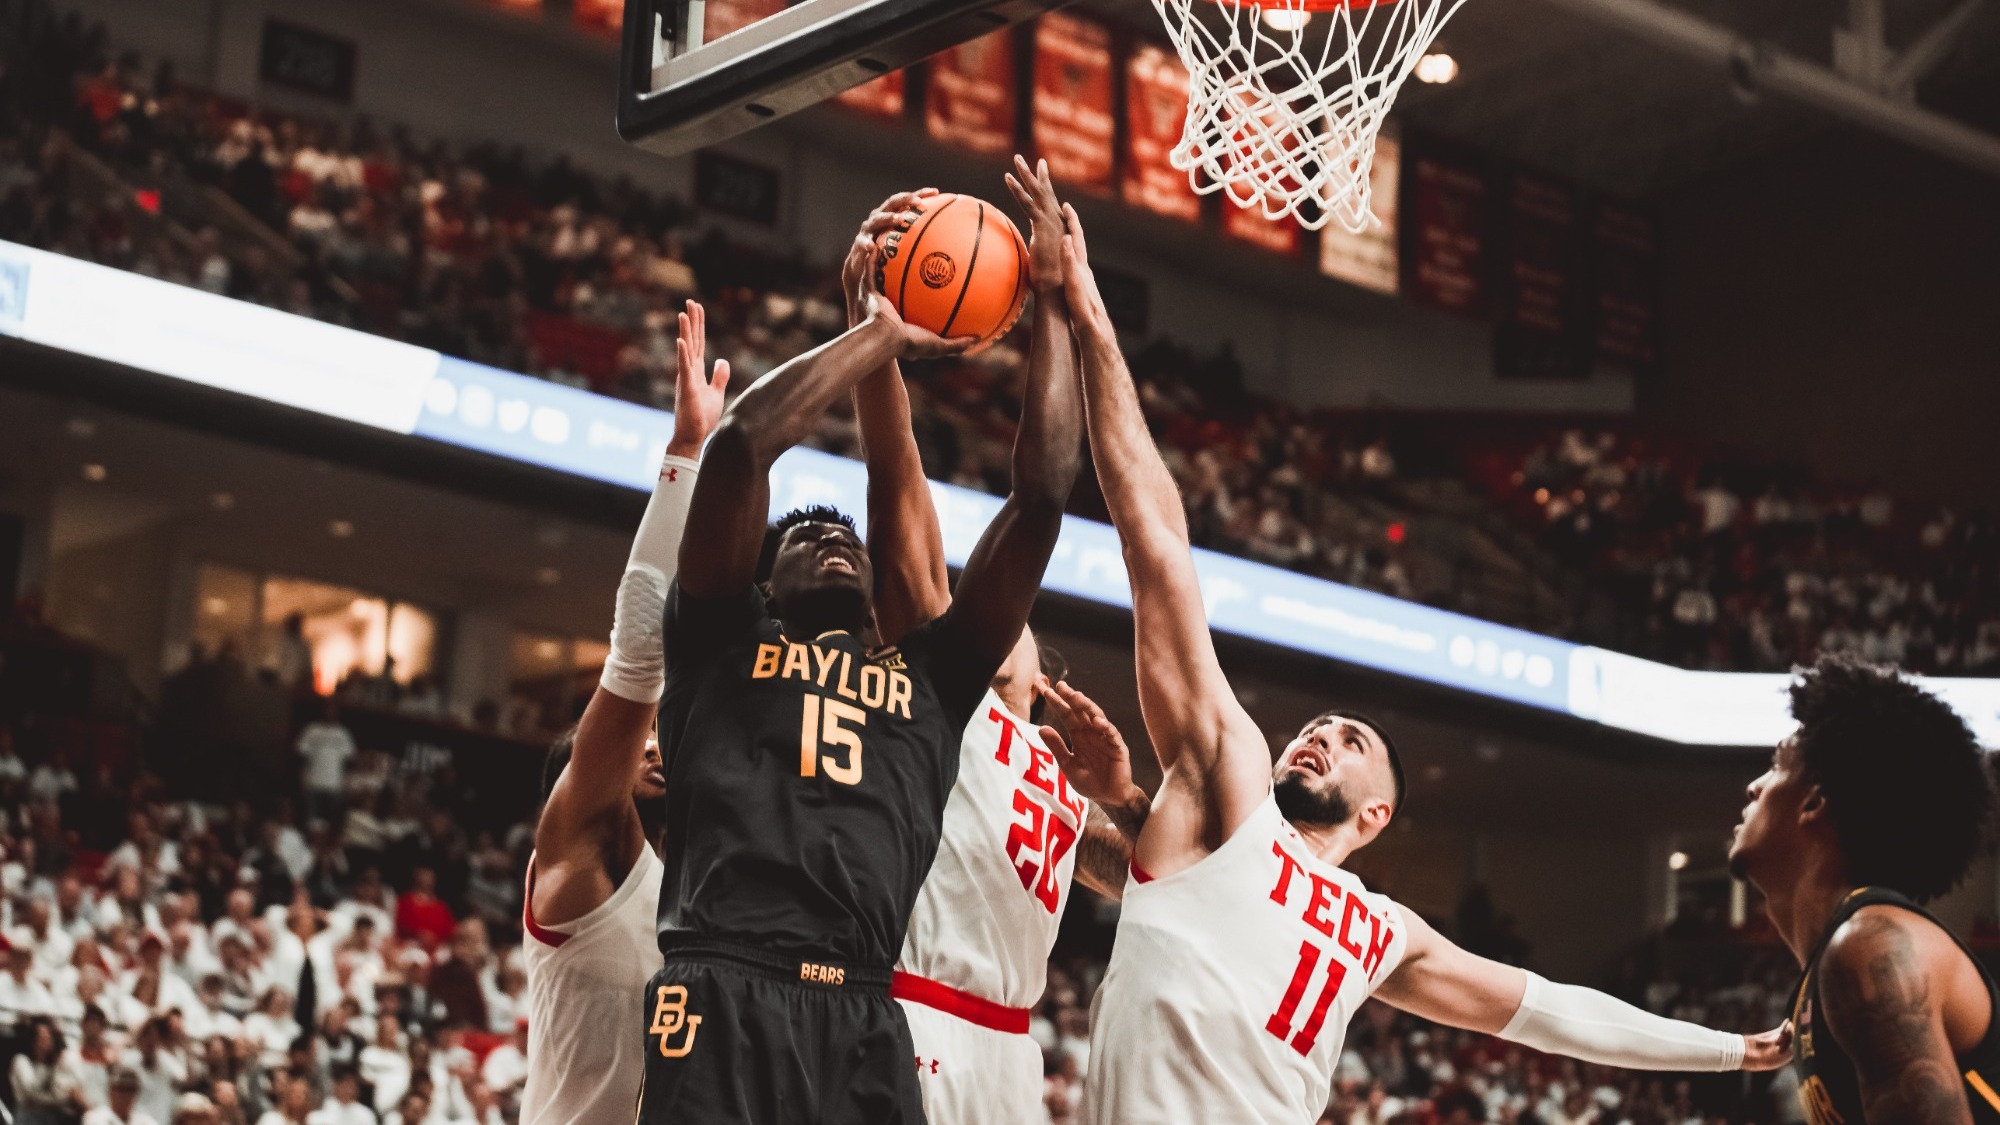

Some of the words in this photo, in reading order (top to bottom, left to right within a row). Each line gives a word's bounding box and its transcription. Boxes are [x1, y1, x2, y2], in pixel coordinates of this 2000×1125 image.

[752, 643, 912, 719] BAYLOR
[800, 693, 866, 785] 15
[1005, 788, 1077, 914] 20
[1269, 839, 1394, 984] TECH
[801, 962, 845, 985] BEARS
[1265, 939, 1347, 1058] 11
[650, 985, 702, 1058] BU
